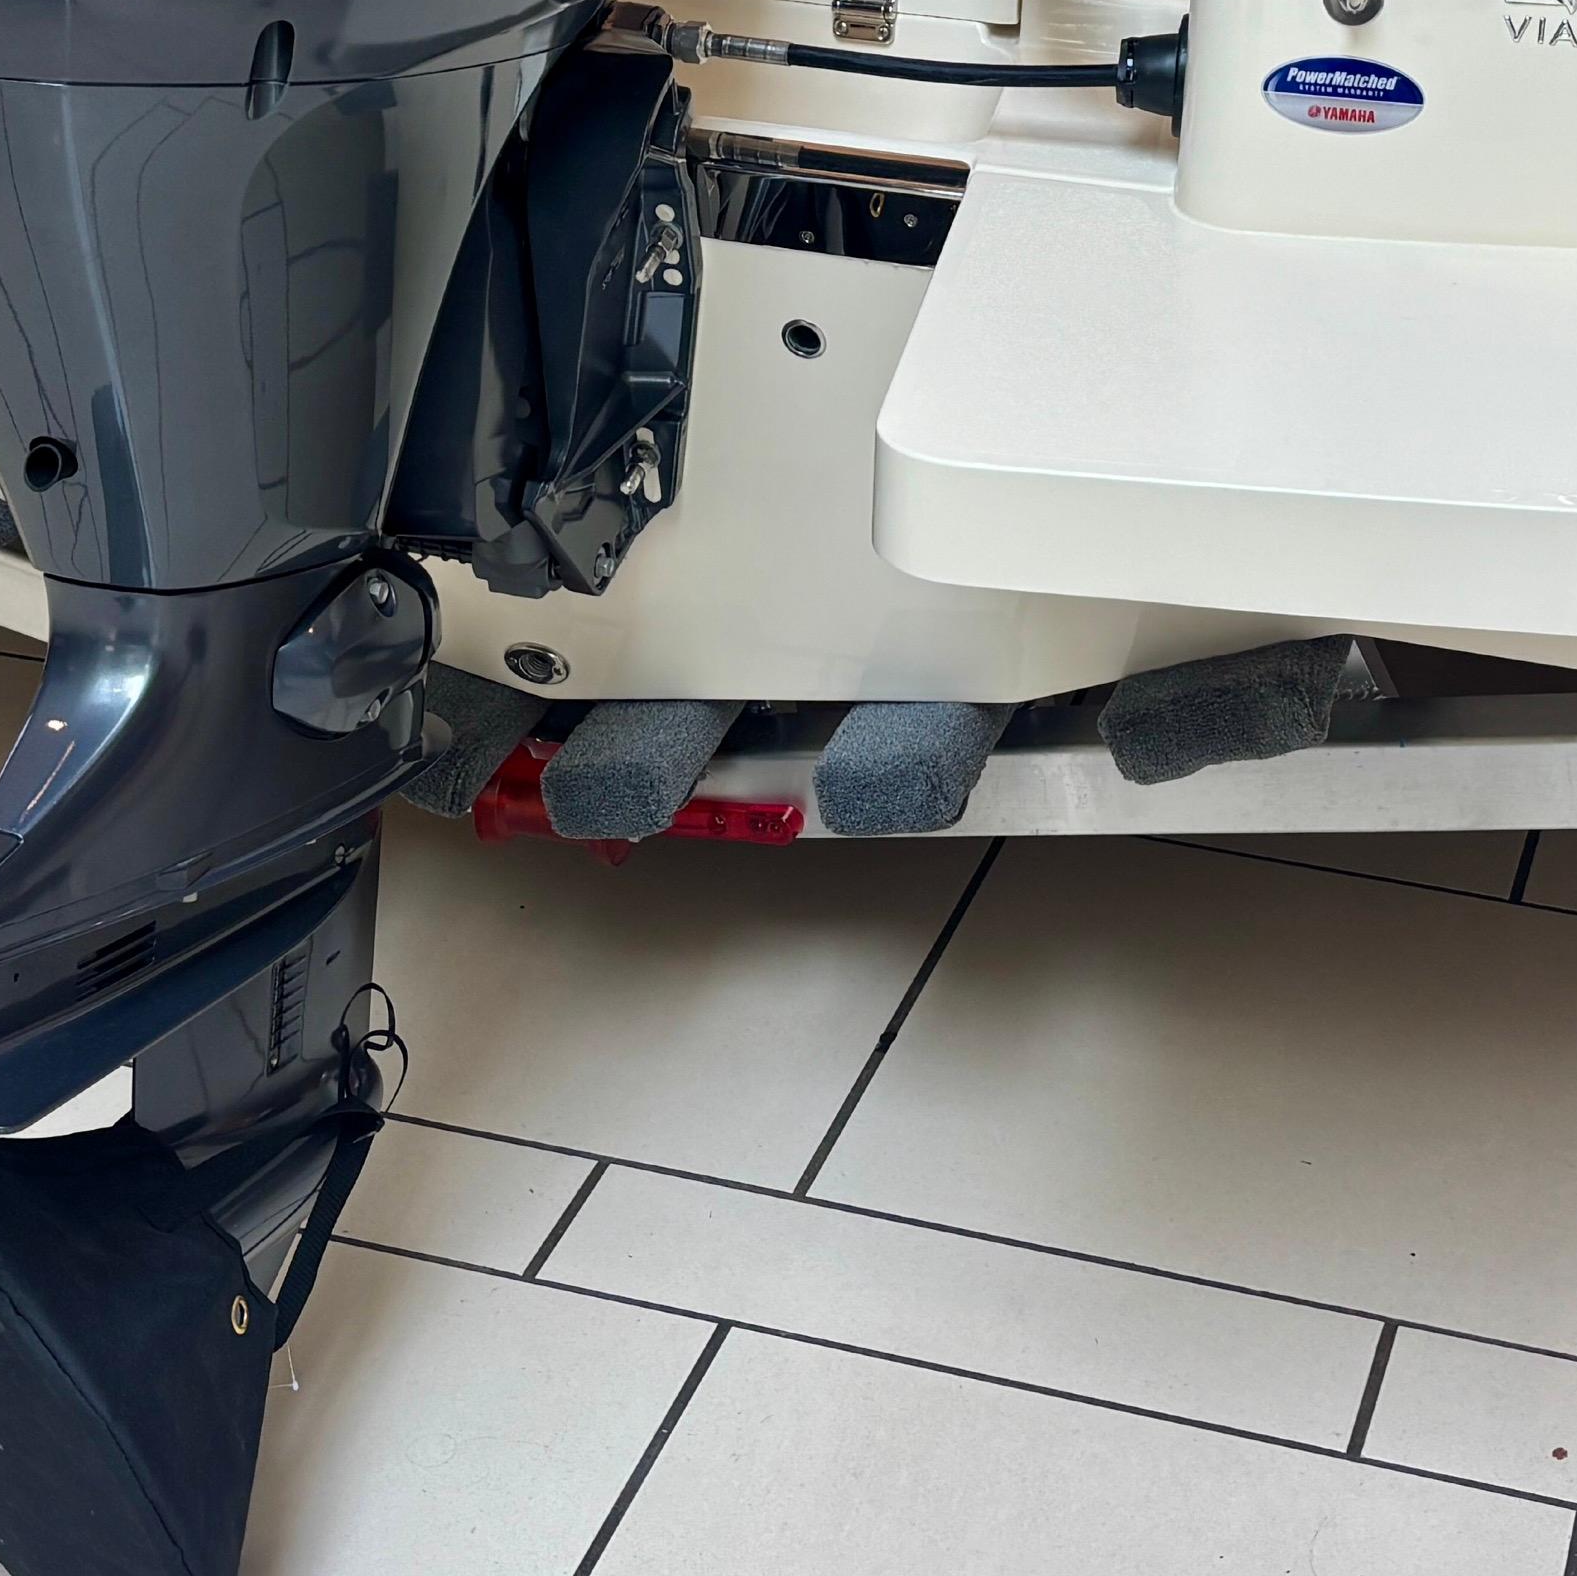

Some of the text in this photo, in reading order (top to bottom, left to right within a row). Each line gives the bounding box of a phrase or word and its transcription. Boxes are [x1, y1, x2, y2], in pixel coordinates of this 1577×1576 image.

[1286, 67, 1398, 91] PowerMatched
[1299, 84, 1384, 98] SYSTEM WARRANTY
[1323, 107, 1375, 124] YAMAHA
